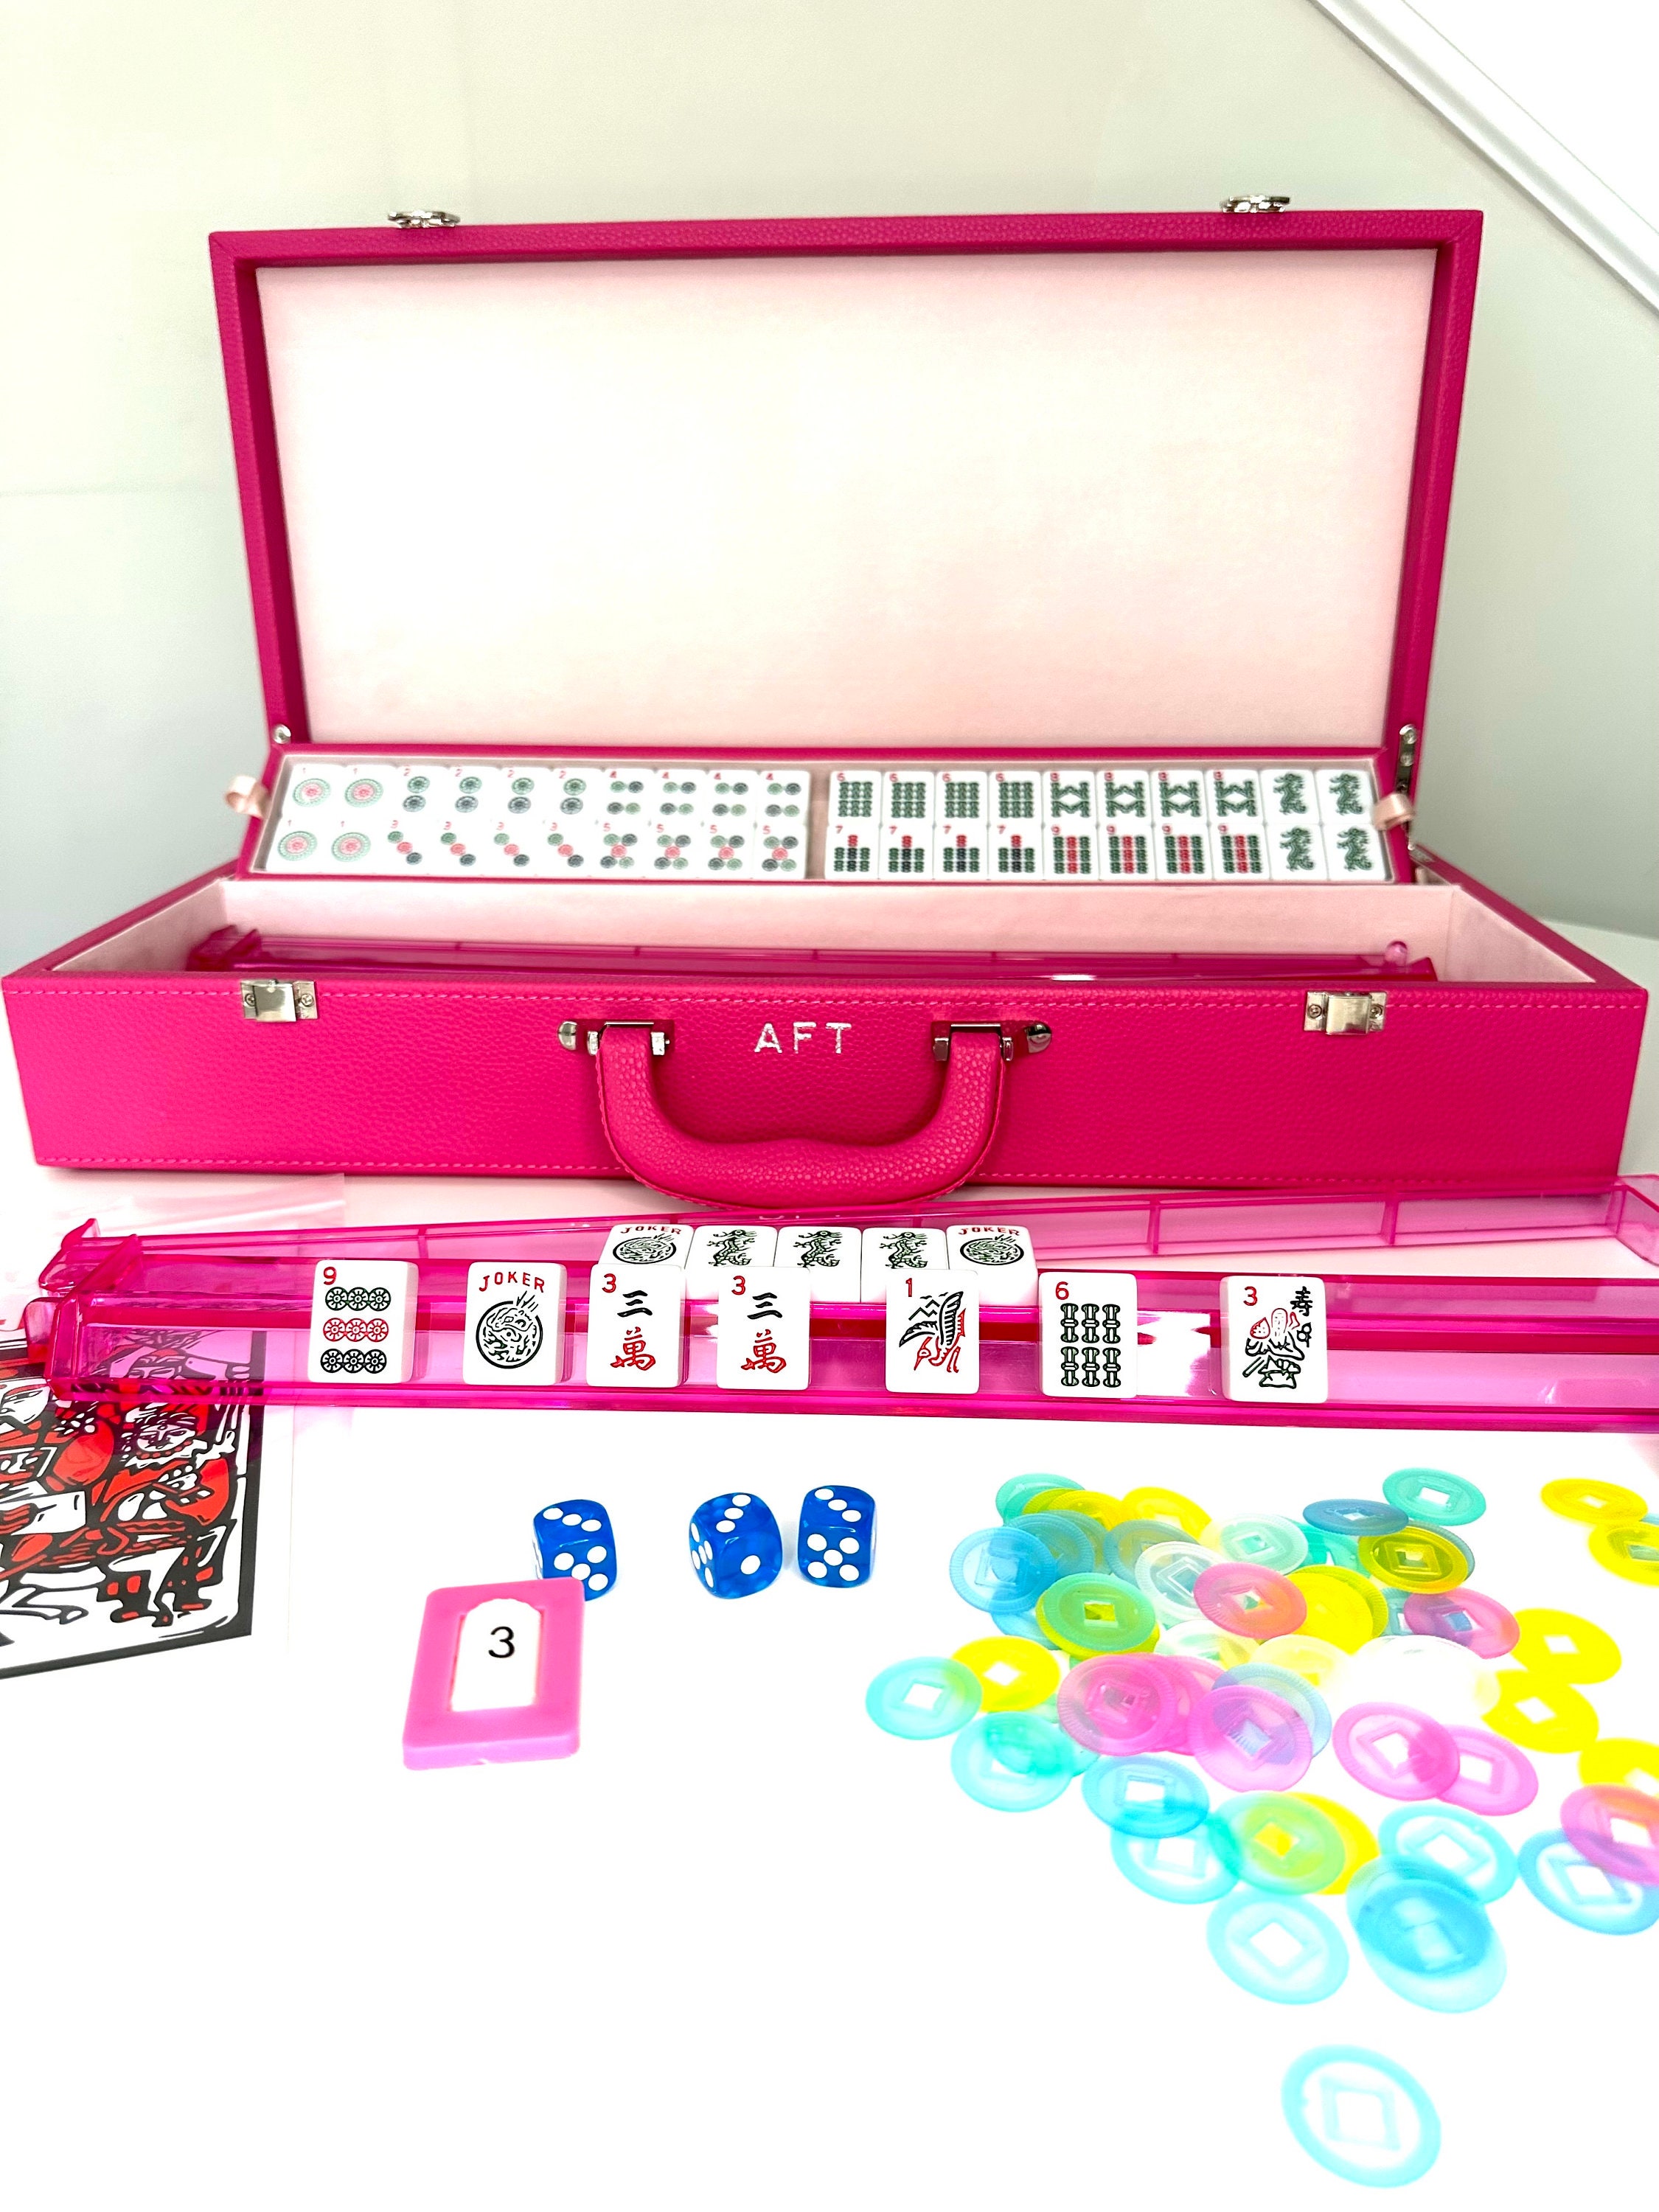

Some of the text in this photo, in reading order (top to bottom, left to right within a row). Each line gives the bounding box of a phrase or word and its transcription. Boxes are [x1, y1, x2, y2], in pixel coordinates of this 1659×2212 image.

[507, 769, 515, 779] 2
[835, 825, 844, 834] 7
[888, 825, 897, 834] 7
[942, 825, 951, 834] 7
[997, 825, 1006, 834] 7
[754, 1022, 852, 1054] AFT
[620, 1225, 682, 1235] JOKER
[958, 1226, 1021, 1236] JOKER
[323, 1266, 337, 1285] 9
[479, 1272, 545, 1292] JOKER
[602, 1273, 616, 1293] 3
[731, 1276, 746, 1295] 3
[905, 1278, 913, 1297] 1
[1055, 1281, 1069, 1300] 6
[1244, 1286, 1259, 1307] 3
[488, 1626, 515, 1658] 3
